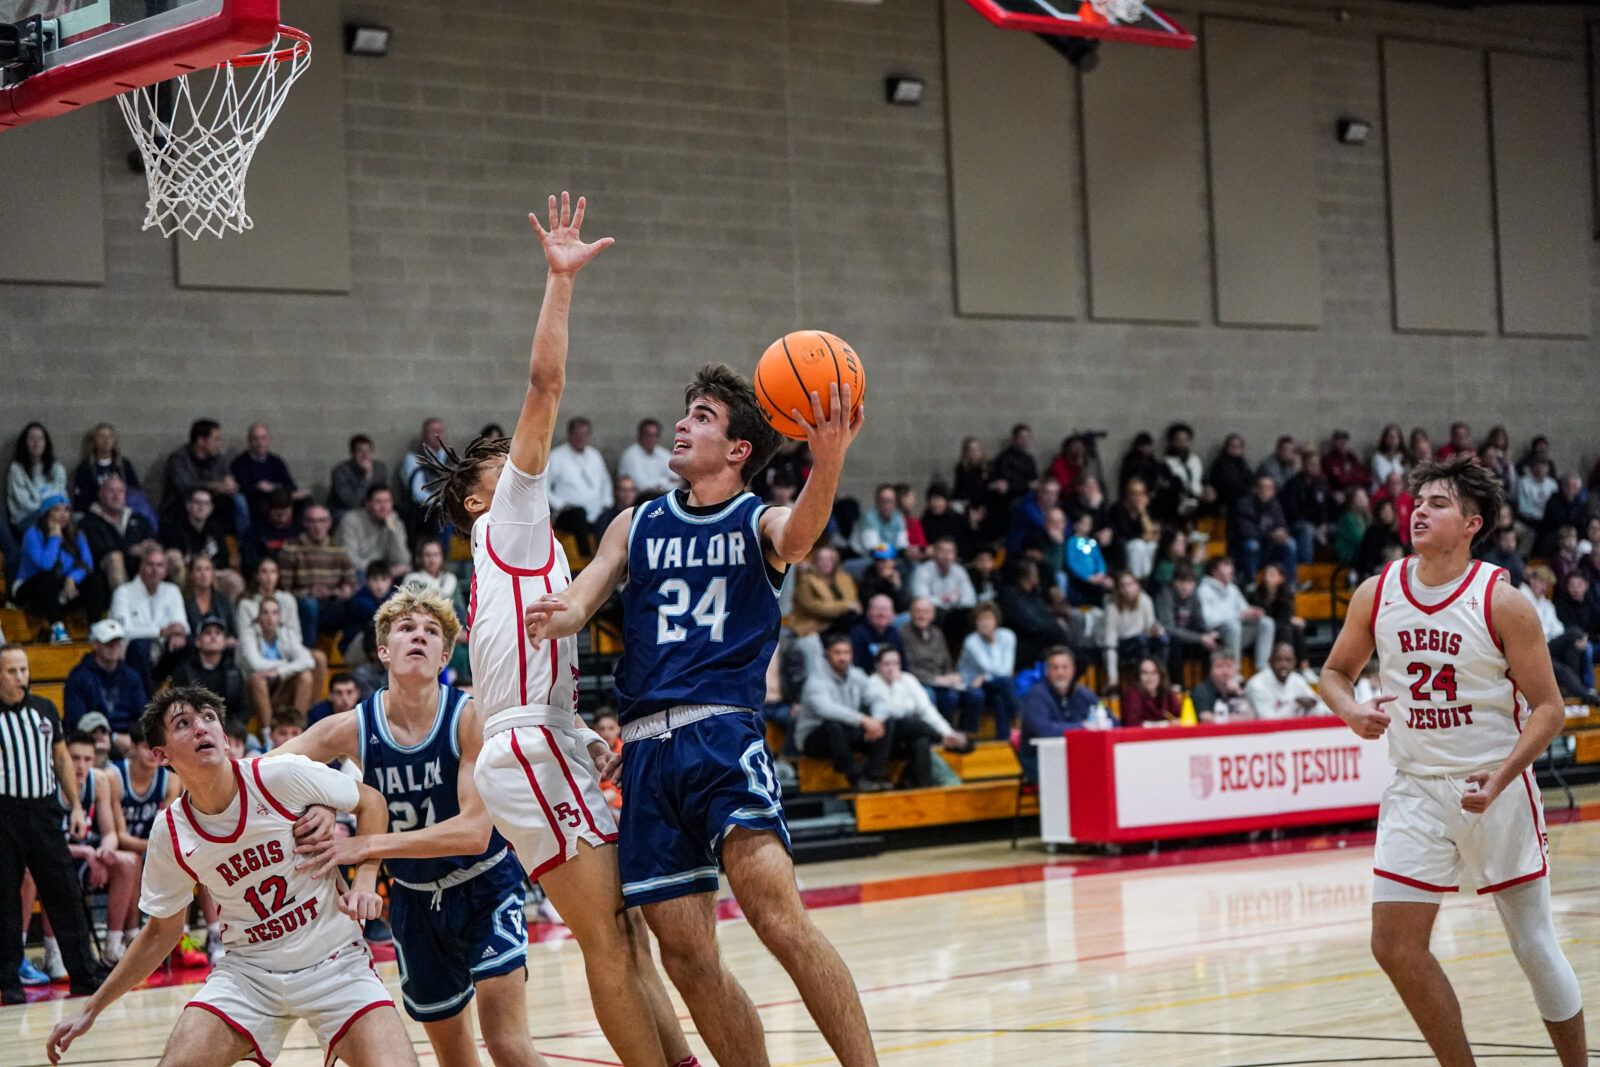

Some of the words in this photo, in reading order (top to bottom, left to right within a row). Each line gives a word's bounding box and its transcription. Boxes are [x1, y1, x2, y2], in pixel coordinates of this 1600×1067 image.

[646, 531, 747, 570] VALOR
[656, 576, 731, 645] 24
[1397, 629, 1463, 656] REGIS
[1406, 662, 1458, 702] 24
[1406, 704, 1474, 730] JESUIT
[1218, 752, 1287, 793] REGIS
[1291, 745, 1362, 796] JESUIT
[215, 840, 285, 887] REGIS
[243, 875, 297, 922] 12
[243, 896, 319, 945] JESUIT
